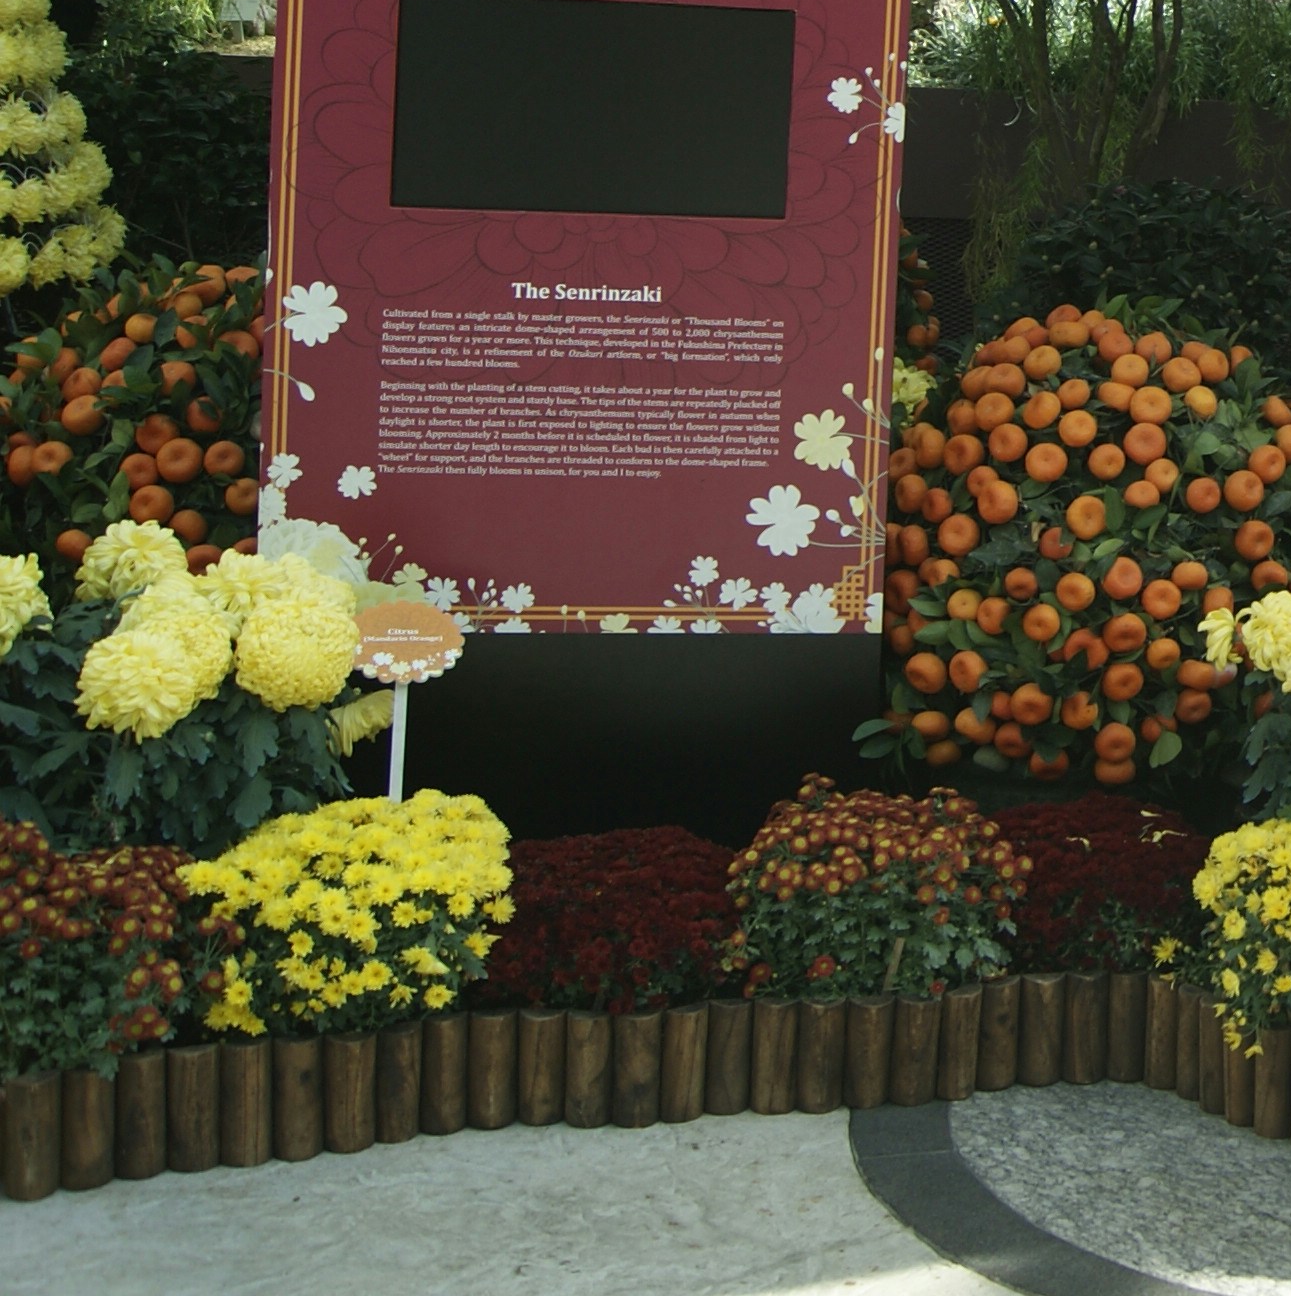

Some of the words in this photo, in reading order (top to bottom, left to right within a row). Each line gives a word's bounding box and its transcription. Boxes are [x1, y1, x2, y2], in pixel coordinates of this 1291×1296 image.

[512, 282, 549, 299] The
[555, 282, 661, 301] Senrinzaki
[383, 309, 428, 318] Cultivated
[431, 310, 452, 319] from
[464, 311, 490, 321] single
[494, 312, 514, 321] stalk
[518, 312, 528, 322] by
[532, 312, 562, 322] master
[606, 314, 620, 324] the
[624, 315, 669, 325] Senrinzaki
[382, 321, 414, 332] display
[419, 322, 454, 331] features
[474, 323, 511, 333] intricate
[515, 324, 575, 335] dome-shaped
[579, 325, 635, 337] arrangement
[652, 327, 669, 336] 500
[713, 329, 783, 340] chrysanthemum
[382, 333, 415, 342] flowers
[418, 335, 446, 344] grown
[449, 335, 461, 343] for
[472, 336, 491, 345] year
[534, 336, 553, 346] This
[603, 338, 648, 349] developed
[661, 339, 675, 348] the
[728, 341, 772, 351] Prefecture
[381, 357, 417, 366] reached
[426, 358, 442, 367] few
[445, 359, 483, 368] hundred
[484, 348, 532, 357] refinement
[550, 349, 564, 358] the
[734, 354, 759, 363] which
[764, 354, 782, 365] only
[381, 382, 425, 392] Beginning
[428, 382, 448, 391] with
[450, 383, 465, 392] the
[467, 383, 504, 394] planting
[525, 384, 546, 393] stem
[592, 385, 615, 394] takes
[618, 386, 642, 395] about
[653, 388, 671, 397] year
[674, 387, 686, 396] for
[688, 387, 702, 396] the
[705, 388, 727, 398] plant
[740, 390, 762, 398] grow
[765, 389, 781, 398] and
[380, 393, 415, 404] develop
[424, 394, 452, 404] strong
[455, 394, 473, 403] root
[475, 394, 506, 405] system
[508, 396, 524, 404] and
[526, 396, 554, 406] sturdy
[581, 397, 597, 406] The
[599, 397, 615, 407] tips
[627, 398, 641, 407] the
[643, 398, 668, 407] stems
[686, 399, 731, 410] repeatedly
[733, 400, 767, 410] plucked
[769, 400, 781, 410] off
[380, 404, 388, 414] to
[392, 405, 429, 414] increase
[432, 406, 446, 415] the
[450, 406, 484, 415] number
[545, 408, 556, 417] As
[559, 408, 634, 419] chrysanthemums
[638, 410, 674, 420] typically
[677, 410, 705, 419] flower
[720, 410, 753, 420] autumn
[756, 412, 780, 421] when
[379, 417, 414, 427] daylight
[465, 419, 479, 427] the
[482, 419, 505, 429] plant
[518, 420, 536, 428] first
[539, 420, 575, 430] exposed
[578, 420, 587, 429] to
[590, 421, 623, 431] lighting
[625, 421, 634, 430] to
[669, 422, 683, 431] the
[686, 422, 718, 432] flowers
[721, 424, 743, 433] grow
[746, 424, 779, 433] without
[425, 430, 491, 441] Approximately
[494, 431, 498, 440] 2
[501, 431, 534, 440] months
[537, 432, 565, 441] before
[586, 433, 630, 442] scheduled
[632, 433, 641, 442] to
[693, 434, 723, 444] shaded
[726, 435, 746, 444] from
[748, 435, 768, 446] light
[770, 435, 779, 445] to
[378, 441, 416, 450] simulate
[419, 442, 451, 451] shorter
[454, 442, 469, 452] day
[472, 443, 500, 453] length
[502, 443, 511, 452] to
[513, 445, 558, 454] encourage
[569, 444, 578, 453] to
[612, 445, 632, 454] Each
[635, 445, 651, 454] bud
[663, 446, 682, 455] then
[684, 446, 721, 456] carefully
[724, 447, 760, 456] attached
[762, 447, 771, 456] to
[415, 454, 427, 463] for
[469, 455, 486, 464] and
[488, 455, 502, 464] the
[505, 455, 544, 464] branches
[563, 456, 602, 465] threaded
[605, 456, 614, 466] to
[616, 457, 652, 466] conform
[654, 457, 663, 466] to
[665, 458, 679, 467] the
[681, 458, 739, 469] dome-shaped
[379, 465, 394, 474] The
[397, 465, 443, 475] Senrinzaki
[445, 466, 465, 475] then
[468, 467, 487, 477] fully
[489, 467, 521, 476] blooms
[568, 468, 581, 477] for
[583, 470, 599, 479] you
[602, 469, 618, 478] and
[625, 469, 634, 478] to
